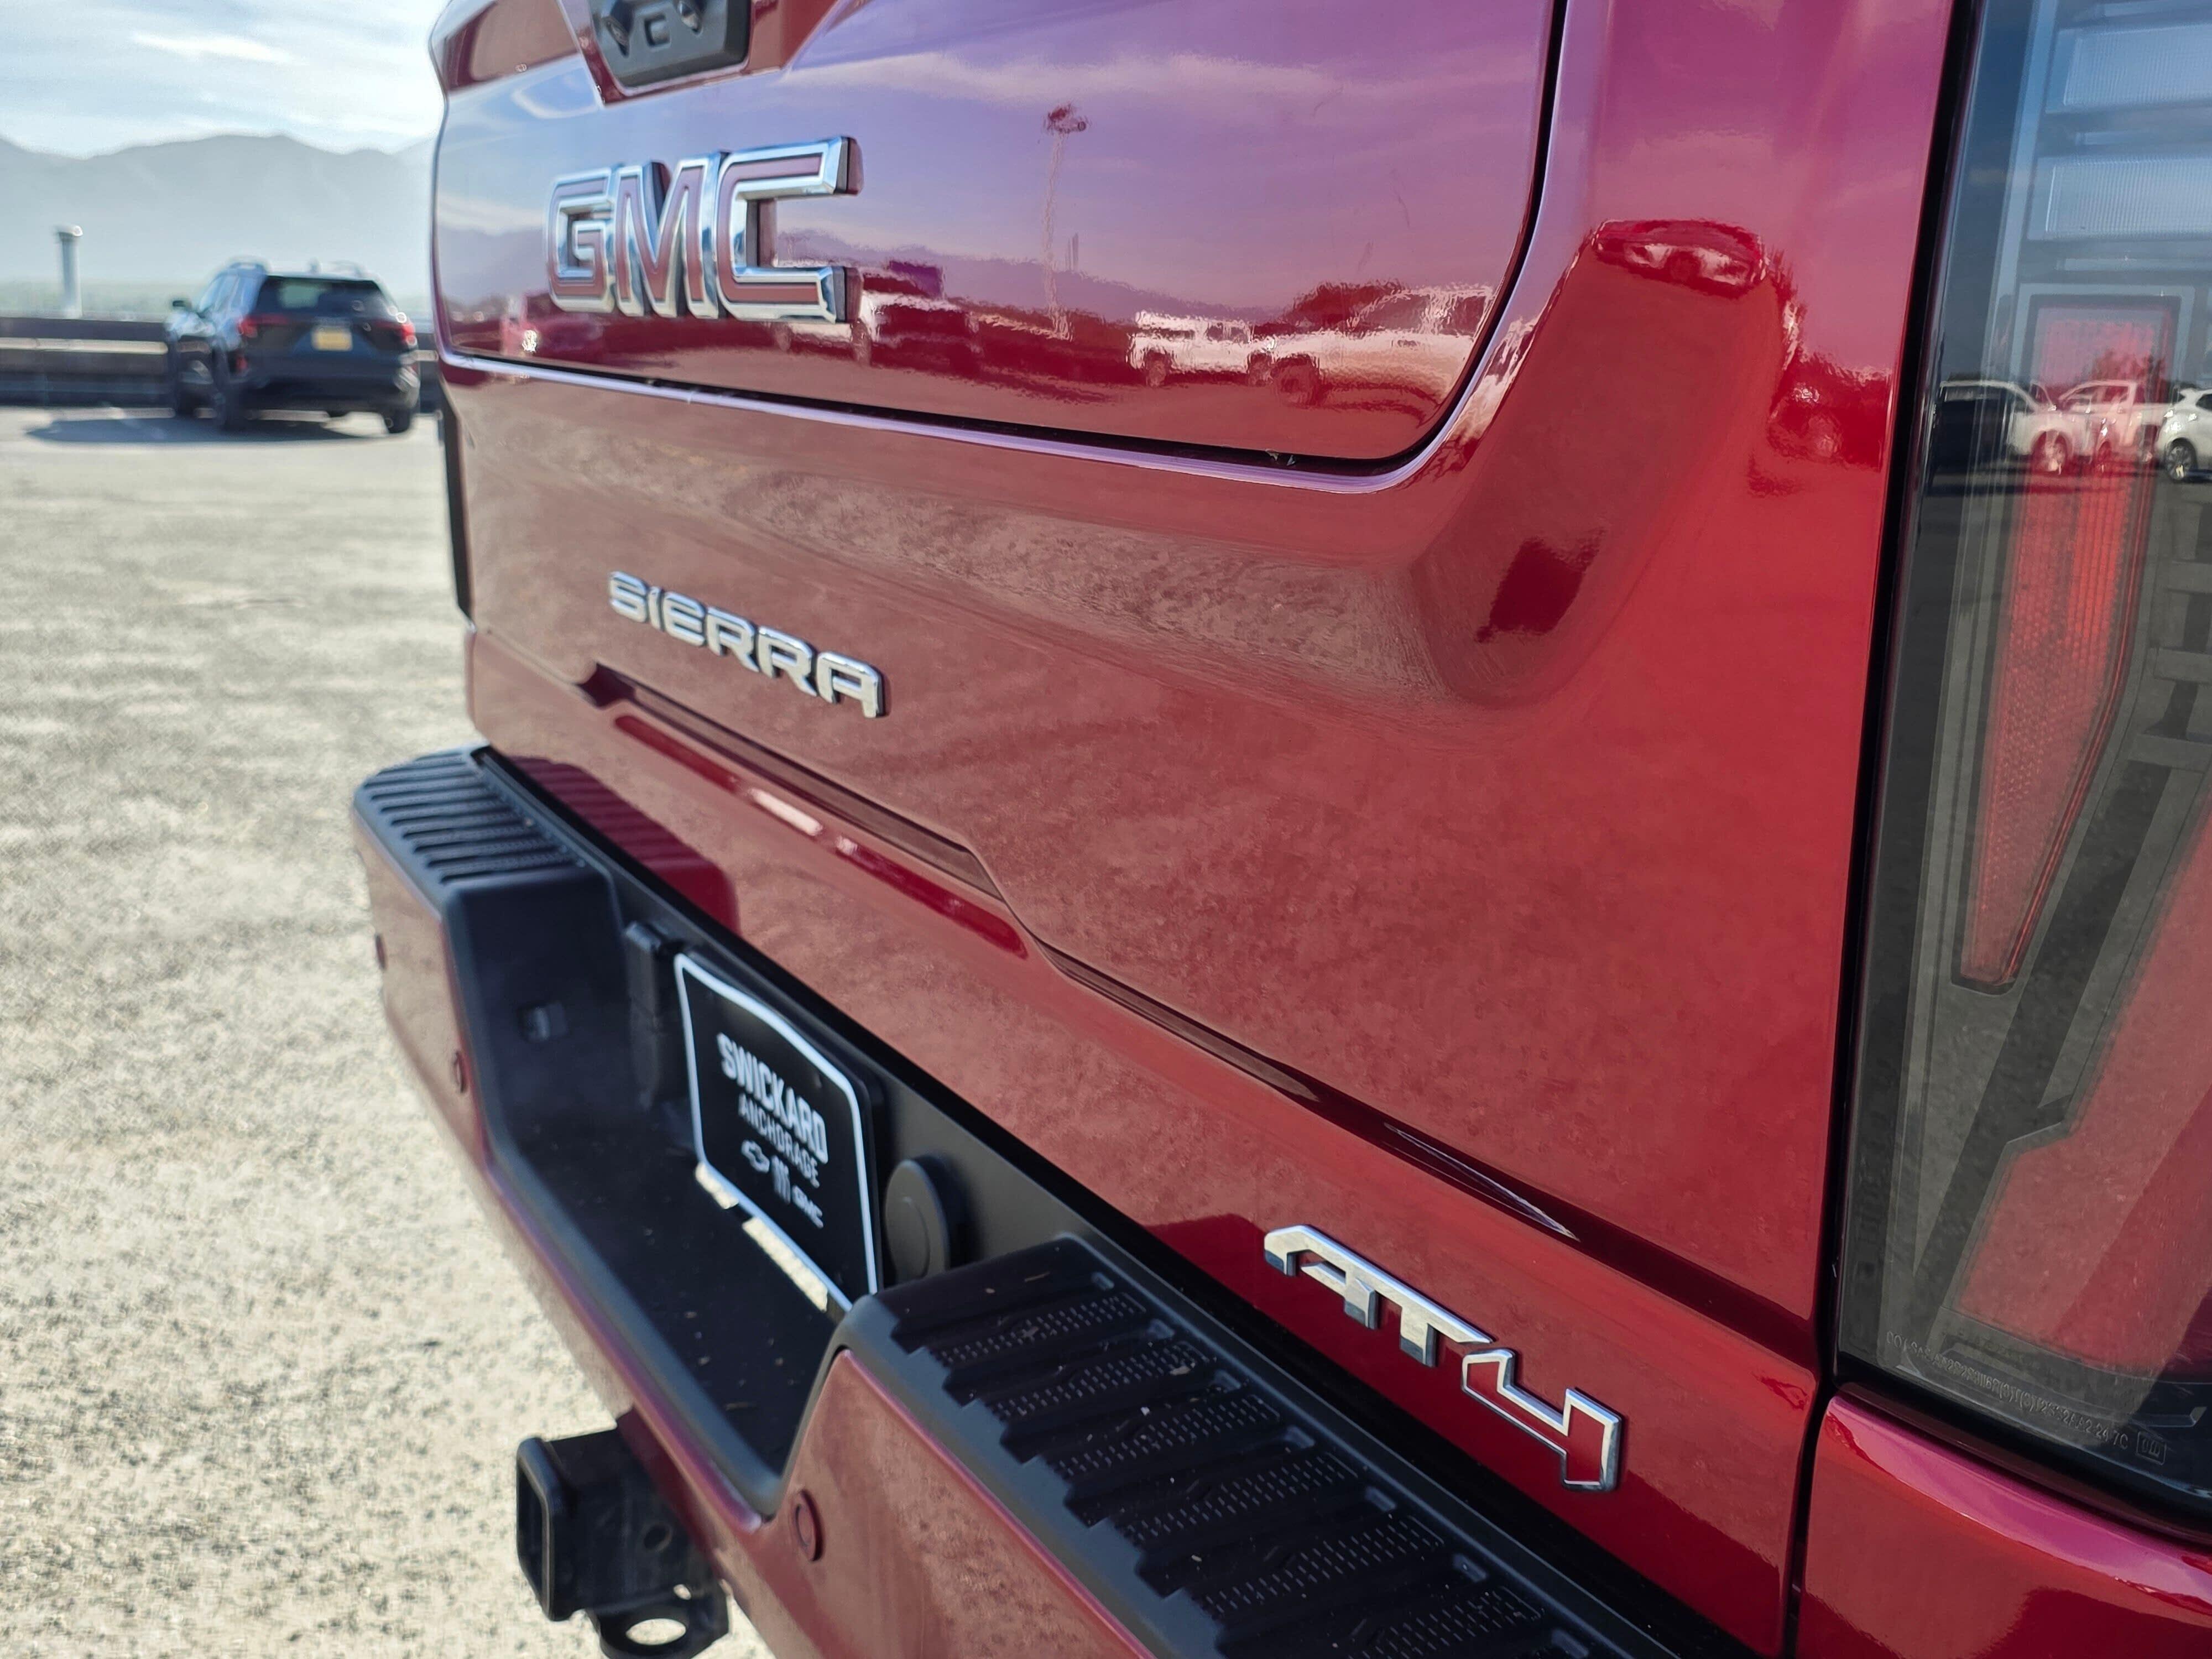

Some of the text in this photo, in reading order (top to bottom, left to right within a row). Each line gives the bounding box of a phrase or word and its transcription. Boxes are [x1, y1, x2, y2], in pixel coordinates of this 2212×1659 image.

[546, 136, 863, 323] GMC
[610, 571, 889, 718] SIERRA
[717, 1032, 828, 1165] SWICKARD
[738, 1093, 820, 1188] ANCHORAGE
[1264, 1224, 1621, 1492] AT4
